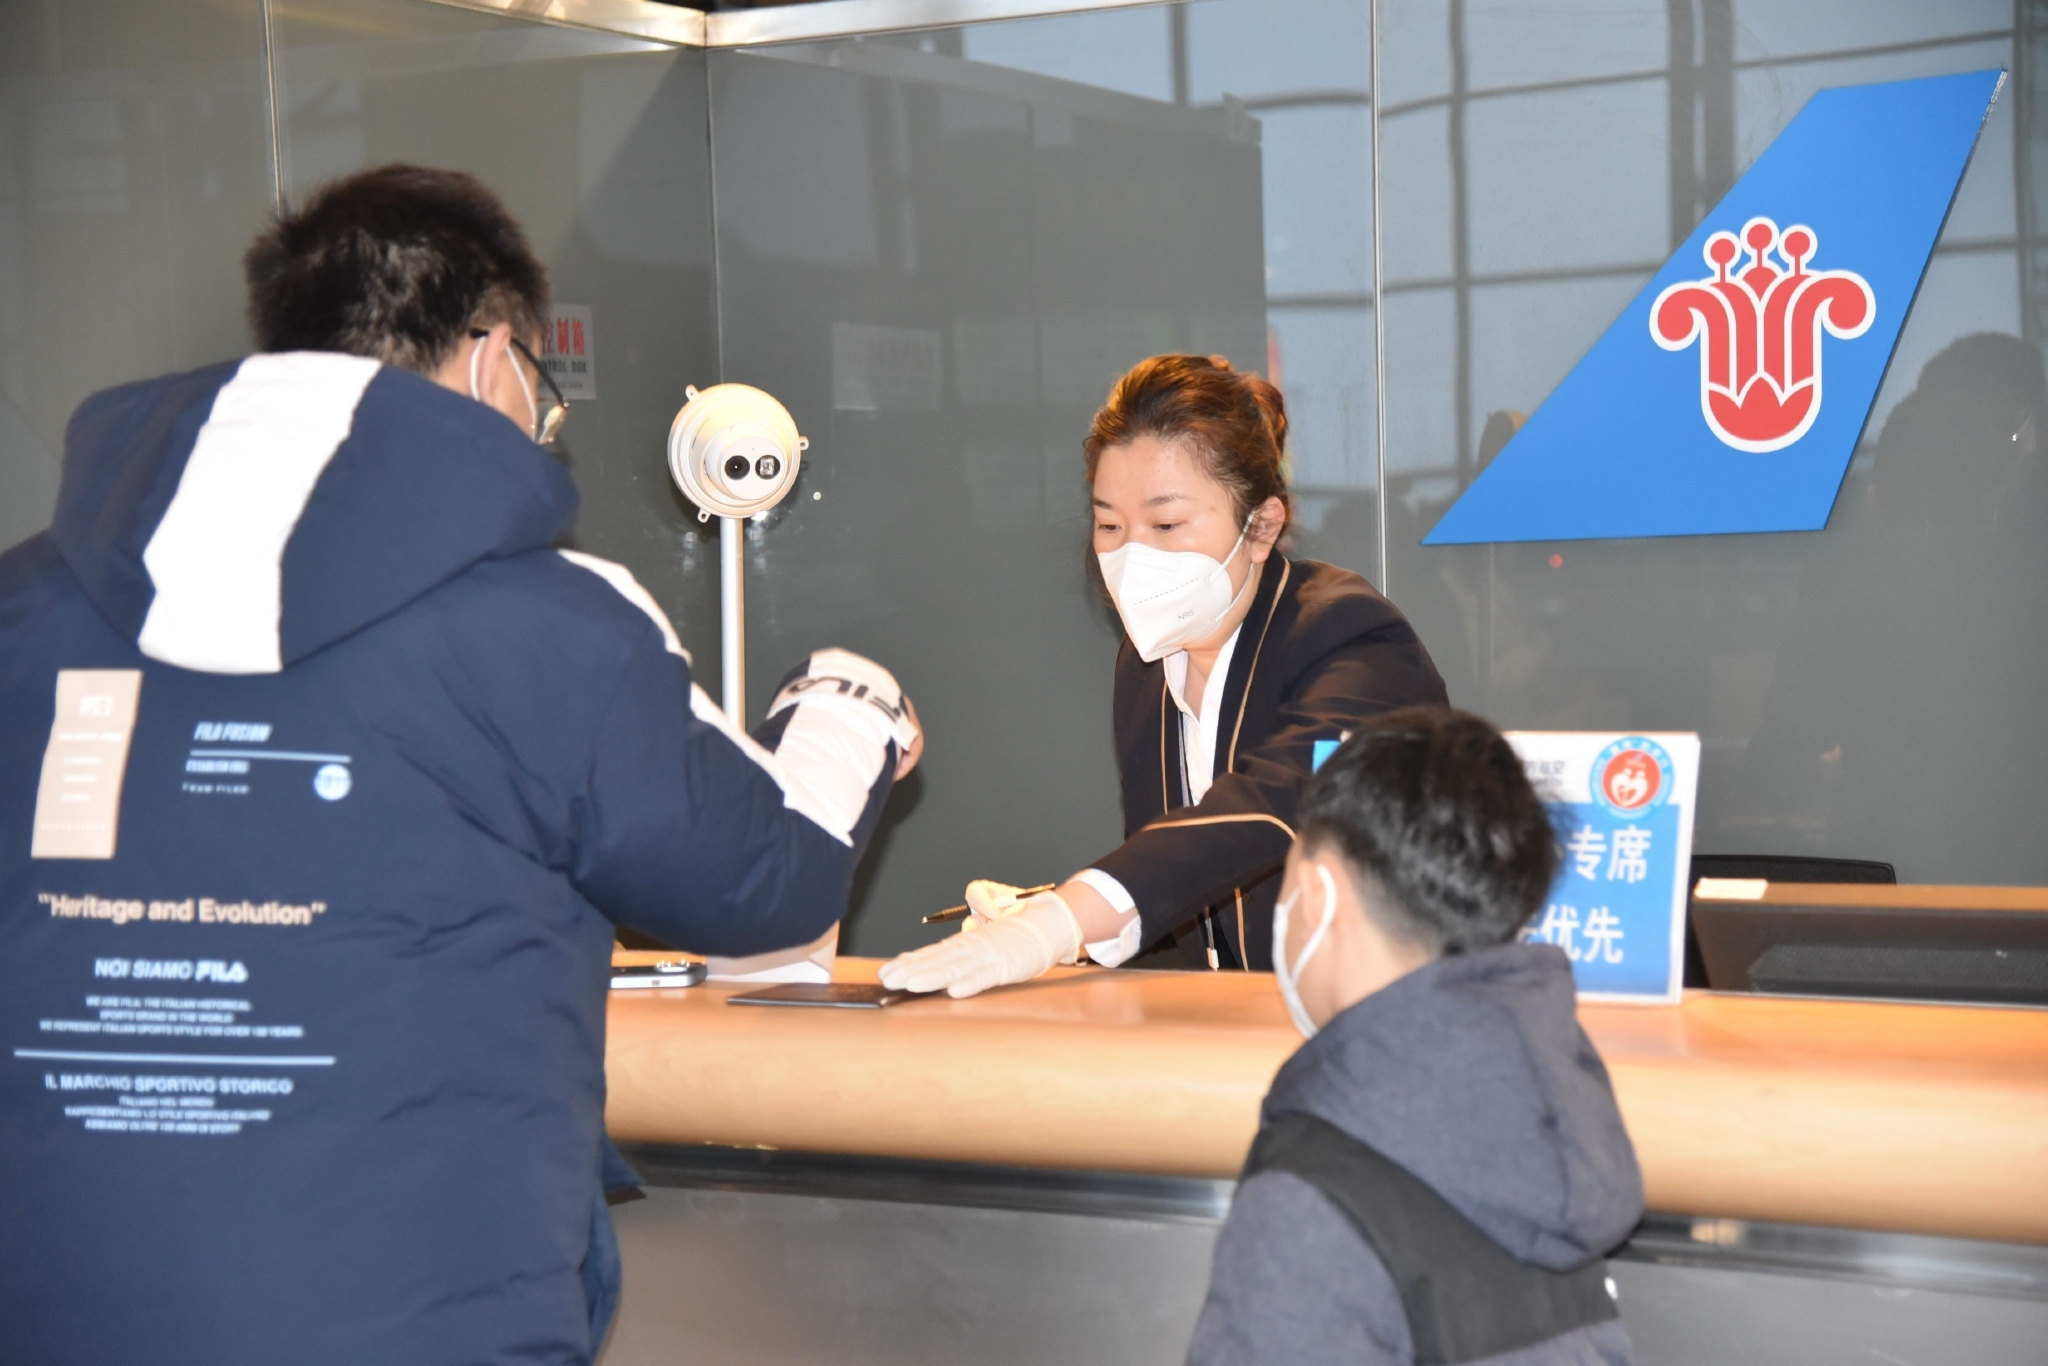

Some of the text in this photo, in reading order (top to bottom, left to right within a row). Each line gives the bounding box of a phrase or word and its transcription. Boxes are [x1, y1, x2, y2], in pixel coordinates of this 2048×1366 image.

[1178, 609, 1195, 621] N95
[194, 722, 271, 742] FILA FUSION
[1558, 824, 1652, 883] 专席
[147, 898, 194, 921] and
[1518, 903, 1625, 964] 优先
[94, 958, 249, 982] NOI SIAMO FILA
[161, 998, 196, 1010] ITALIAN
[222, 1025, 250, 1037] OVER
[45, 1074, 294, 1094] IL MARCHIO SPORTIVO STORICO
